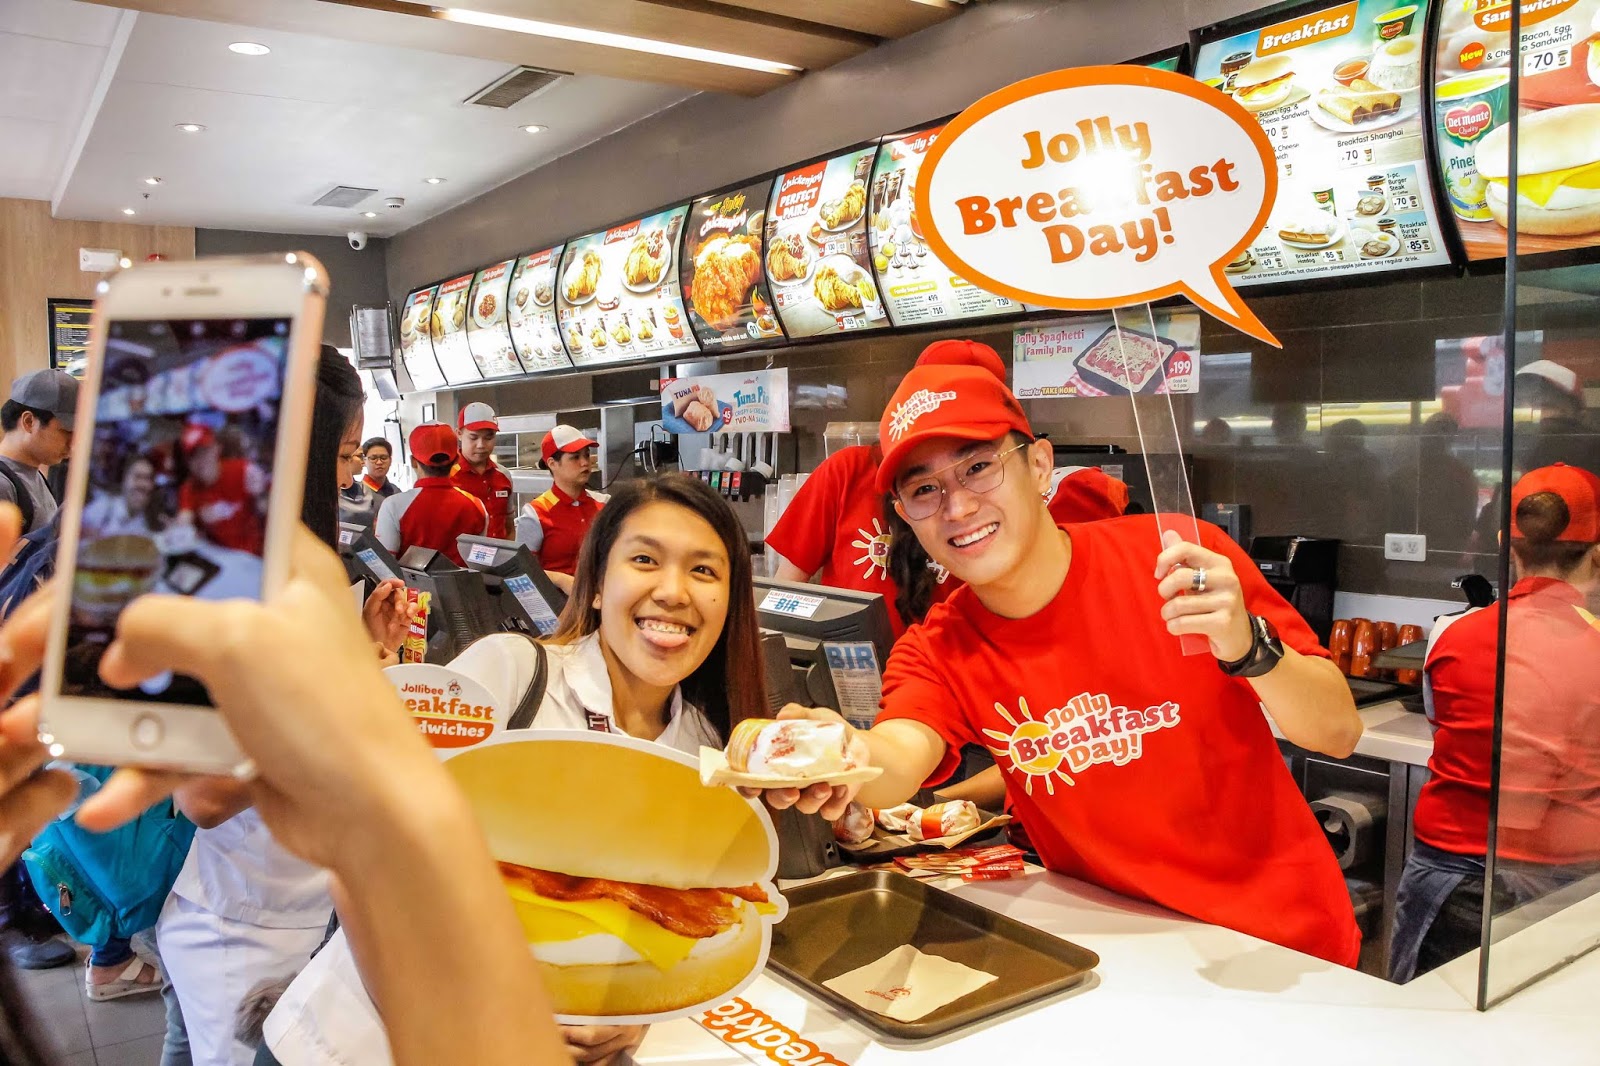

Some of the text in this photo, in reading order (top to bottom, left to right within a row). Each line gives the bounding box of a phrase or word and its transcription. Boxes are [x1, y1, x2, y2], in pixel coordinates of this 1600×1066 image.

[1262, 14, 1350, 50] Breakfast
[1531, 34, 1573, 50] Sandwich
[1460, 49, 1484, 63] New
[1281, 109, 1310, 121] Sandwich
[1448, 111, 1489, 127] Del Monte
[1021, 116, 1152, 170] Jolly
[1337, 128, 1404, 148] Breakfast Shanghai
[1388, 177, 1407, 186] Burger
[1389, 184, 1405, 192] Steak
[780, 187, 818, 207] PERFECT
[954, 158, 1240, 236] Breafast
[1399, 221, 1427, 229] Breakfast
[1401, 227, 1420, 236] Burger
[1041, 207, 1175, 264] Day!
[1016, 329, 1085, 345] Jolly Spaghetti
[1026, 345, 1073, 357] Family Pan
[674, 388, 692, 400] TUNA
[733, 386, 770, 408] Tuna Pie
[905, 390, 927, 409] Jolly
[1019, 388, 1033, 397] Great
[1042, 387, 1058, 395] TAKE
[1058, 386, 1077, 395] HOME
[896, 392, 955, 425] Breakfast
[506, 577, 535, 594] BIR
[774, 598, 799, 612] BIR
[824, 646, 876, 669] BIR
[401, 683, 444, 696] Jollibee
[402, 696, 495, 720] eakfast
[1047, 694, 1109, 731] Jolly
[418, 720, 486, 738] dwiches
[1013, 703, 1177, 763] Breakfast
[1067, 733, 1138, 768] Day!
